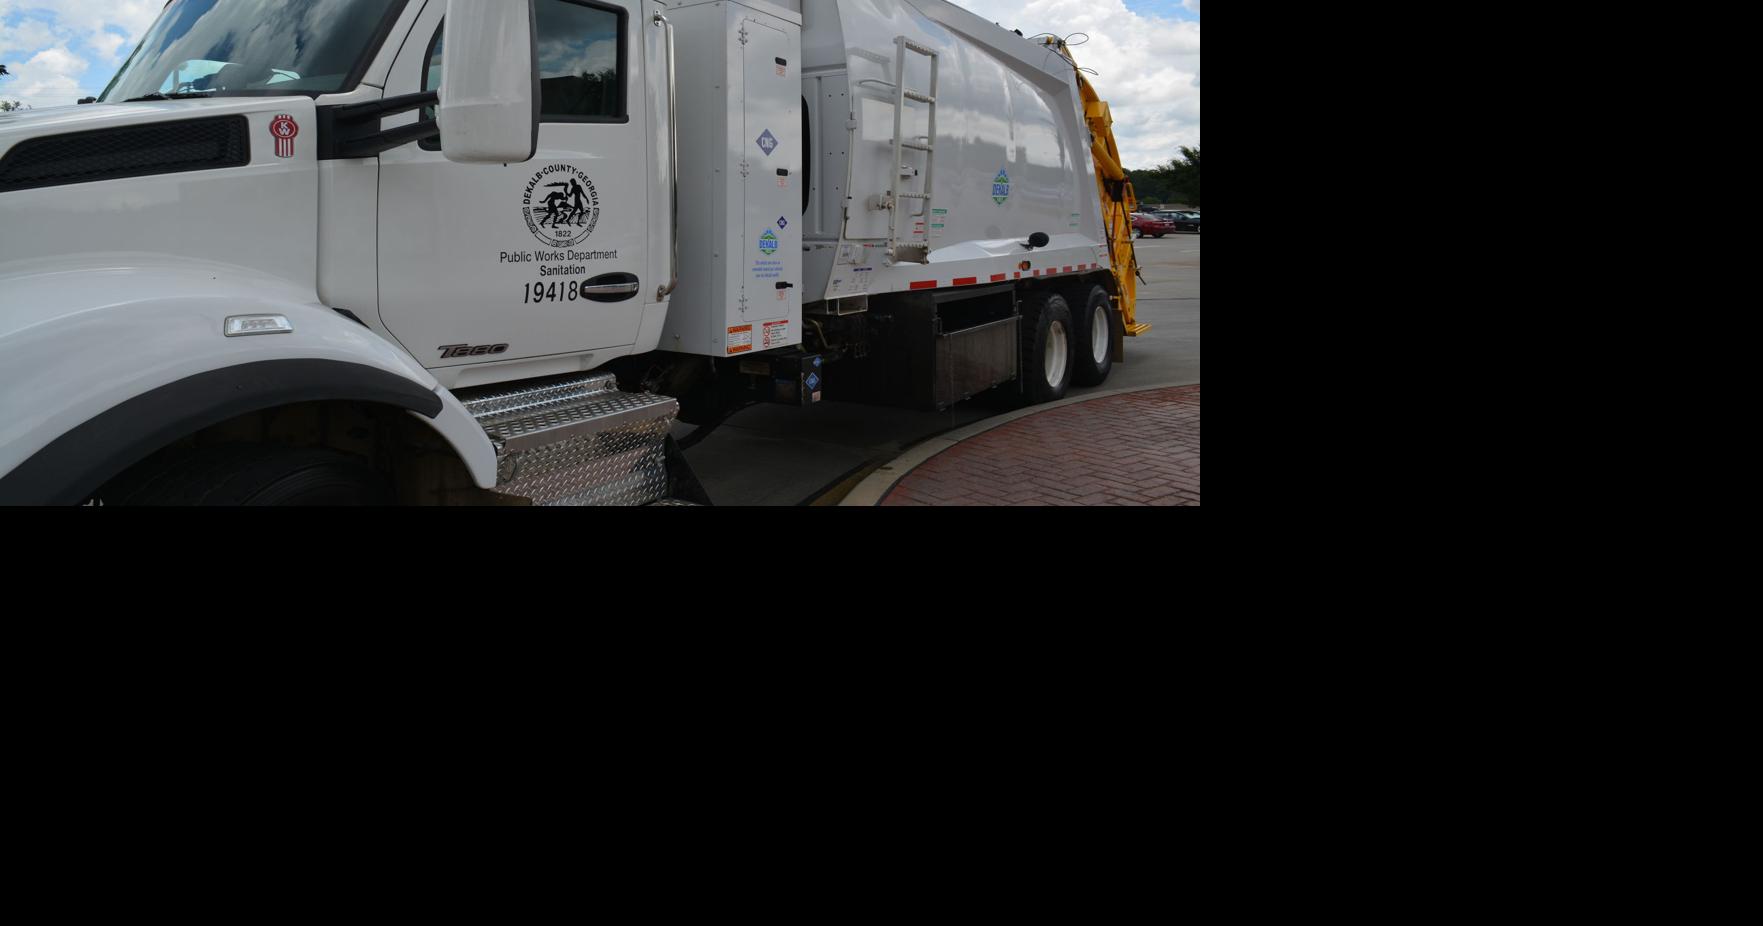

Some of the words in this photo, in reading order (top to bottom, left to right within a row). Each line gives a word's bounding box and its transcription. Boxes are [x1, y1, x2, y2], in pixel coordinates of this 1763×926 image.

[523, 172, 543, 205] DEKALB
[543, 164, 577, 175] COUNTY
[578, 171, 599, 206] GEORGIA
[555, 230, 572, 238] 1822
[500, 251, 532, 263] Public
[535, 250, 565, 262] Works
[567, 249, 618, 262] Department
[540, 264, 586, 276] Sanitation
[524, 280, 578, 304] 19418
[437, 343, 509, 359] T880
